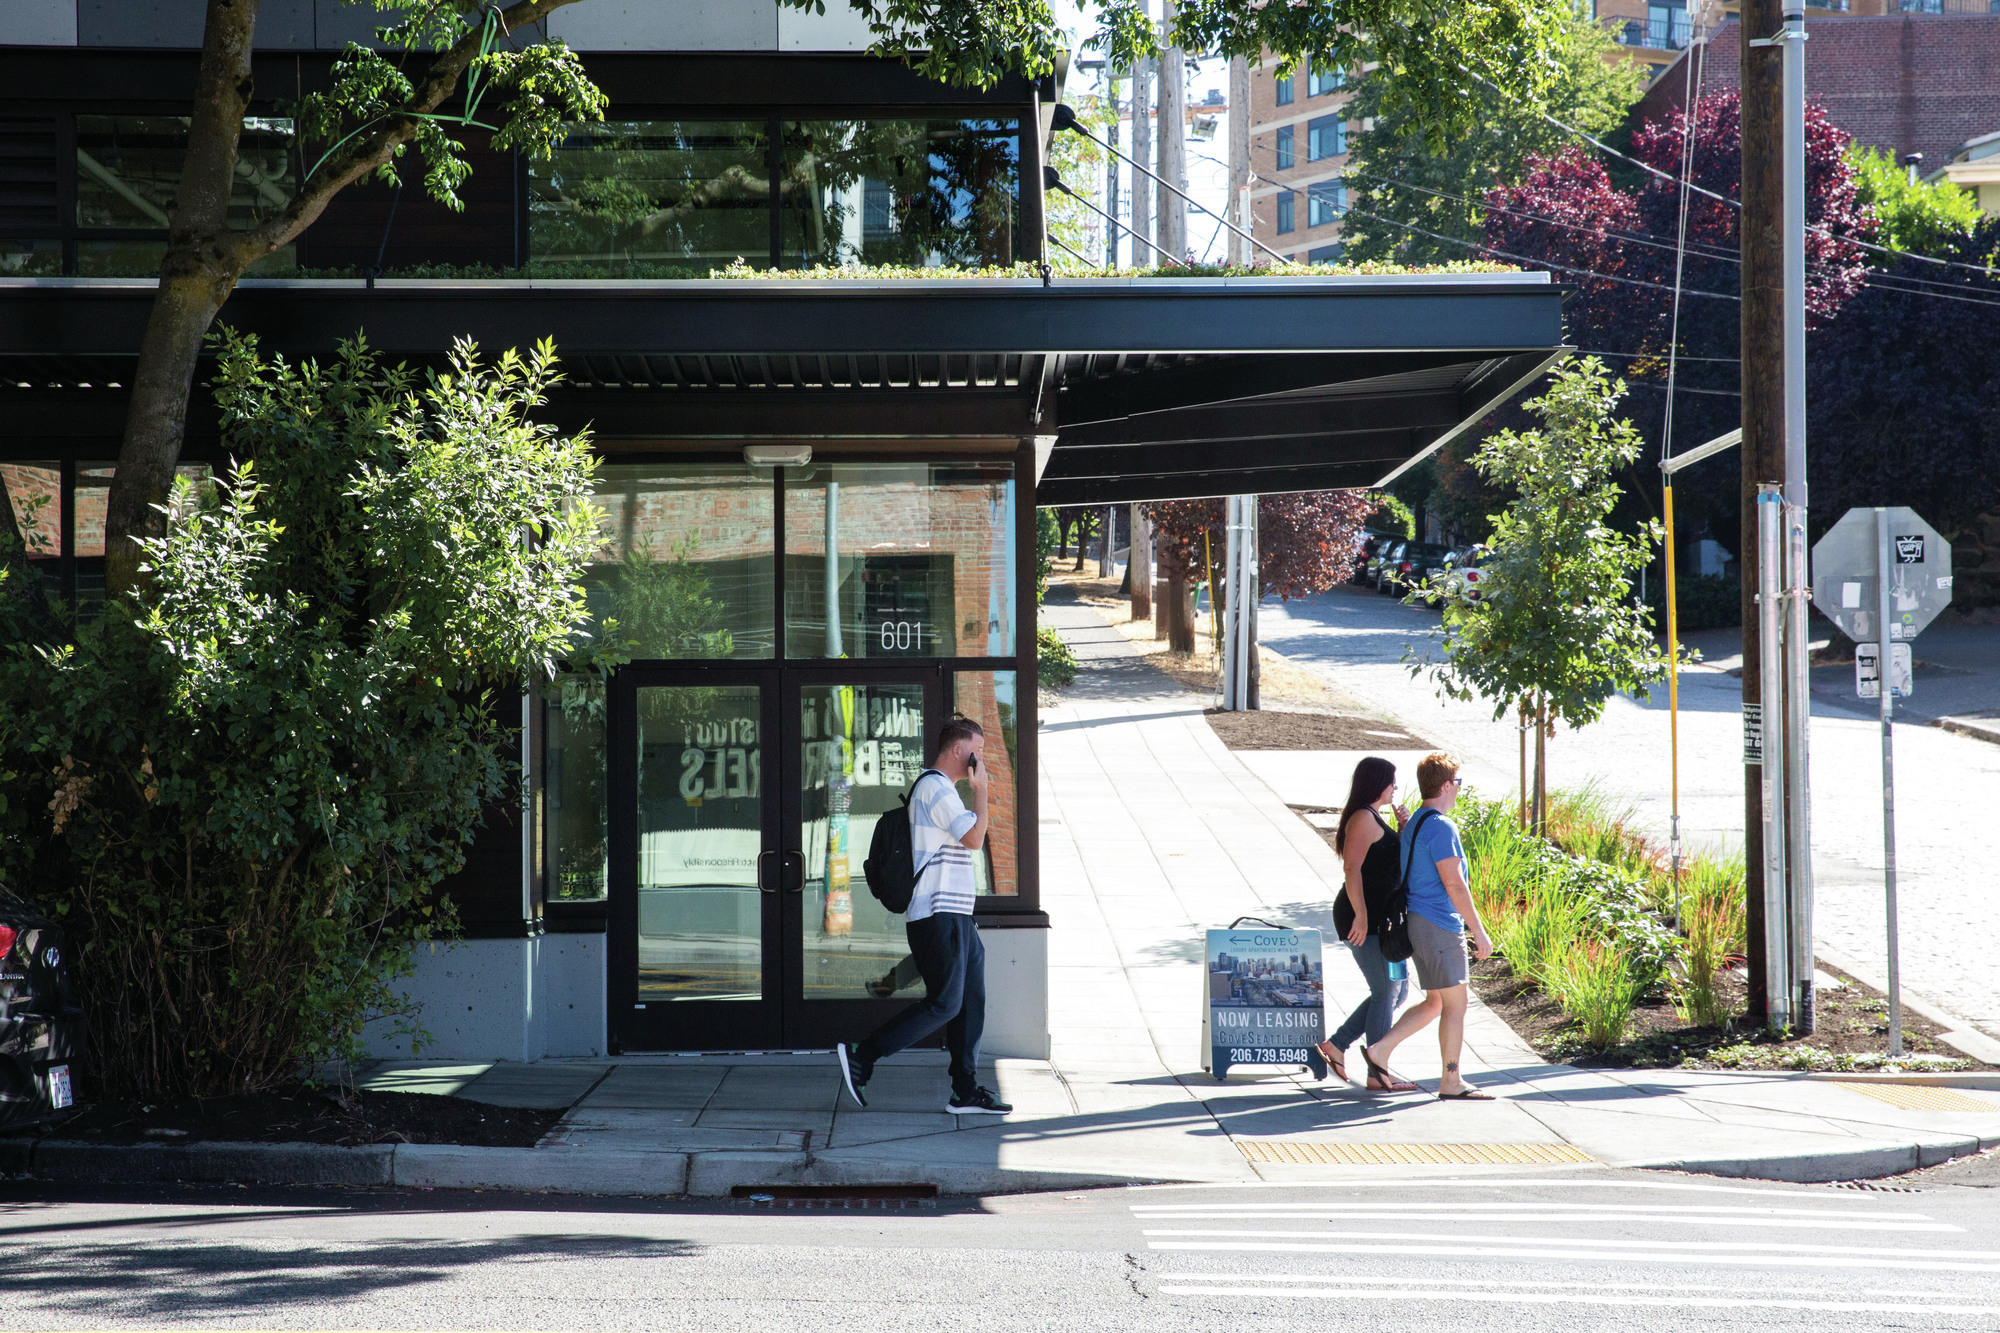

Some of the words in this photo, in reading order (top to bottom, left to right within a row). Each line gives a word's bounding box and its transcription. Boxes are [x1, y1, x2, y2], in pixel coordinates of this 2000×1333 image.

[881, 621, 921, 650] 601
[1254, 935, 1286, 946] COVE
[1218, 1011, 1250, 1027] NOW
[1256, 1012, 1318, 1028] LEASING
[1230, 1048, 1308, 1062] 206.739.5948
